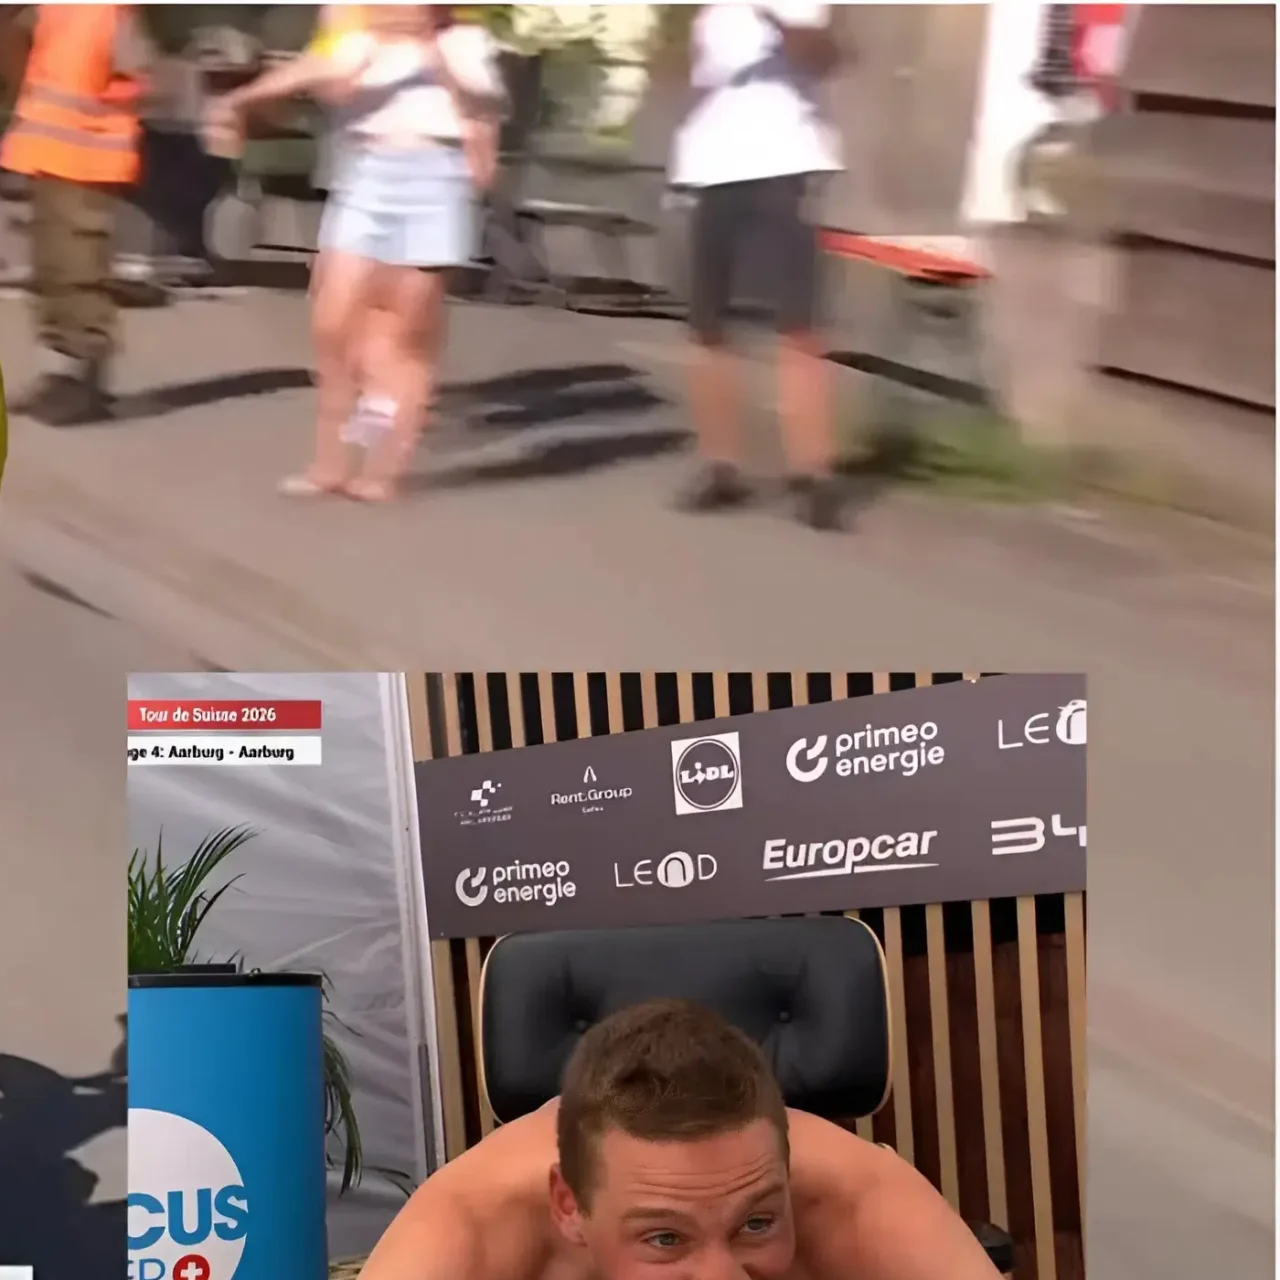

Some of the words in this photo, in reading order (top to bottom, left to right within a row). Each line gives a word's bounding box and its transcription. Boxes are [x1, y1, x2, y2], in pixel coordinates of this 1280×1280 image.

[835, 720, 938, 757] primeo
[835, 743, 946, 778] energie
[762, 829, 938, 874] Europcar
[492, 859, 570, 887] primeo
[493, 880, 577, 906] energie
